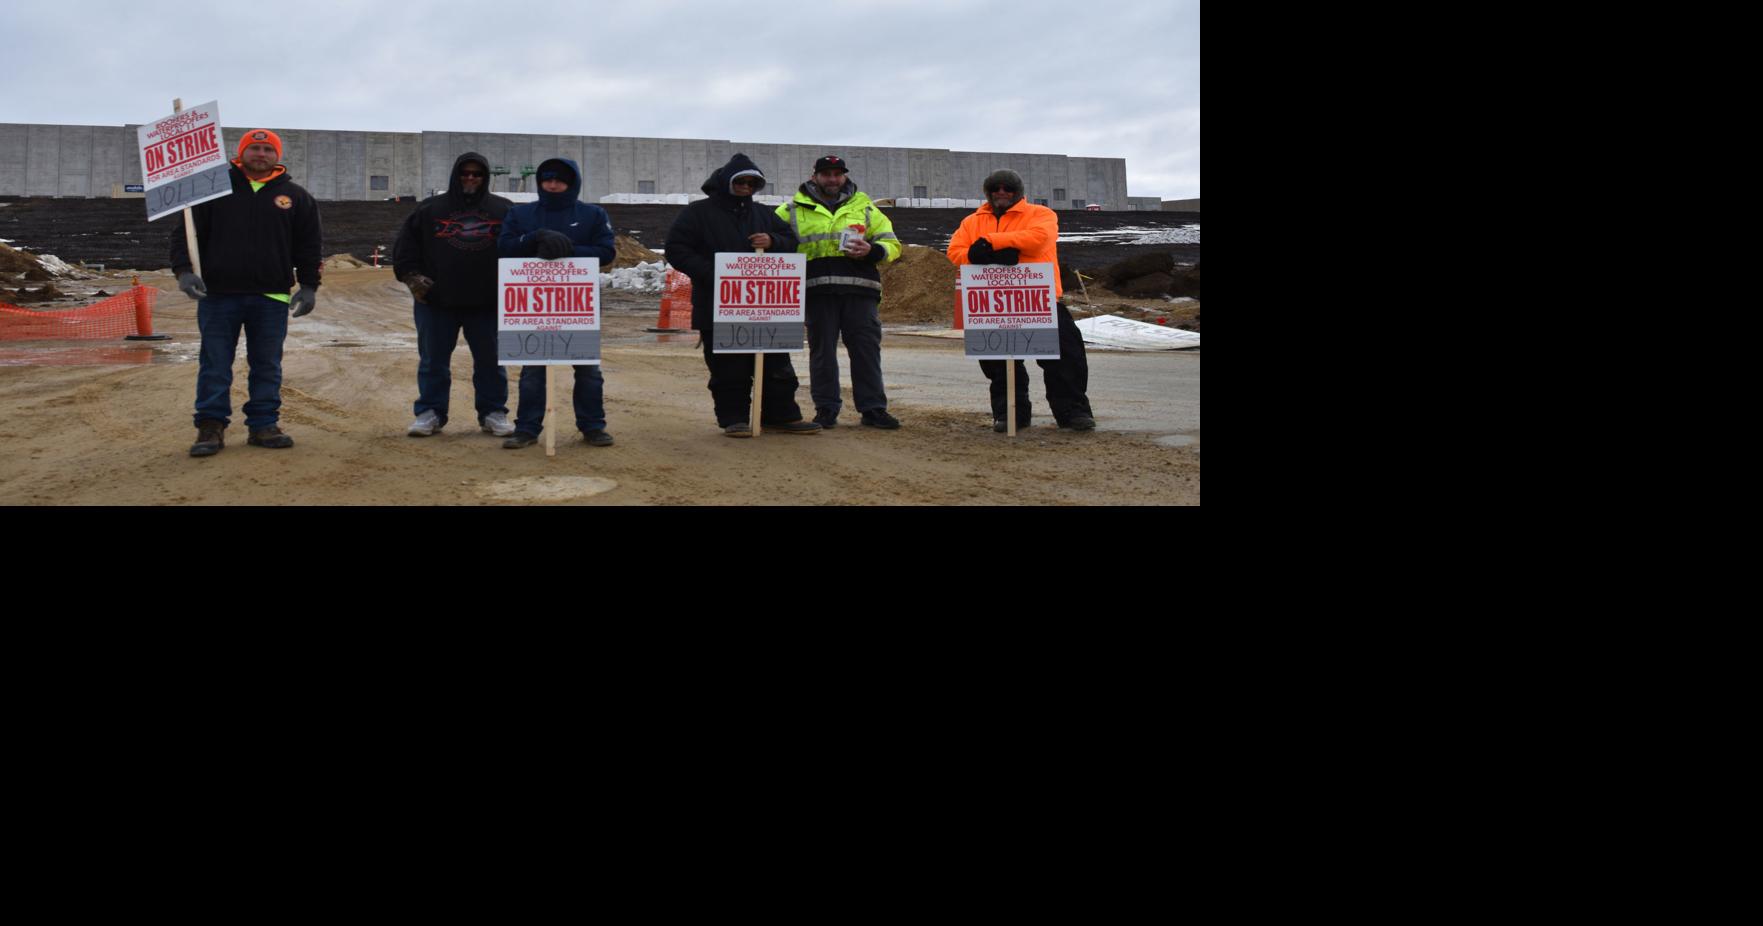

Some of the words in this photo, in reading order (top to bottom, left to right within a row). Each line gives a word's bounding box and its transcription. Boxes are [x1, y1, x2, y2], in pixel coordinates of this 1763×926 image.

[147, 112, 209, 138] WATERPROOFERS
[155, 112, 191, 129] ROOFERS
[160, 127, 185, 140] LOCAL
[145, 145, 165, 172] ON
[166, 126, 218, 164] STRIKE
[147, 175, 161, 185] FOR
[161, 168, 179, 179] AREA
[180, 153, 221, 172] STANDARDS
[151, 171, 217, 212] JOLLY
[510, 268, 588, 276] WATERPROOFERS
[971, 272, 1044, 280] WATERPROOFERS
[504, 287, 528, 312] ON
[532, 287, 594, 312] STRIKE
[720, 280, 741, 304] ON
[745, 280, 800, 304] STRIKE
[967, 289, 990, 313] ON
[993, 289, 1051, 313] STRIKE
